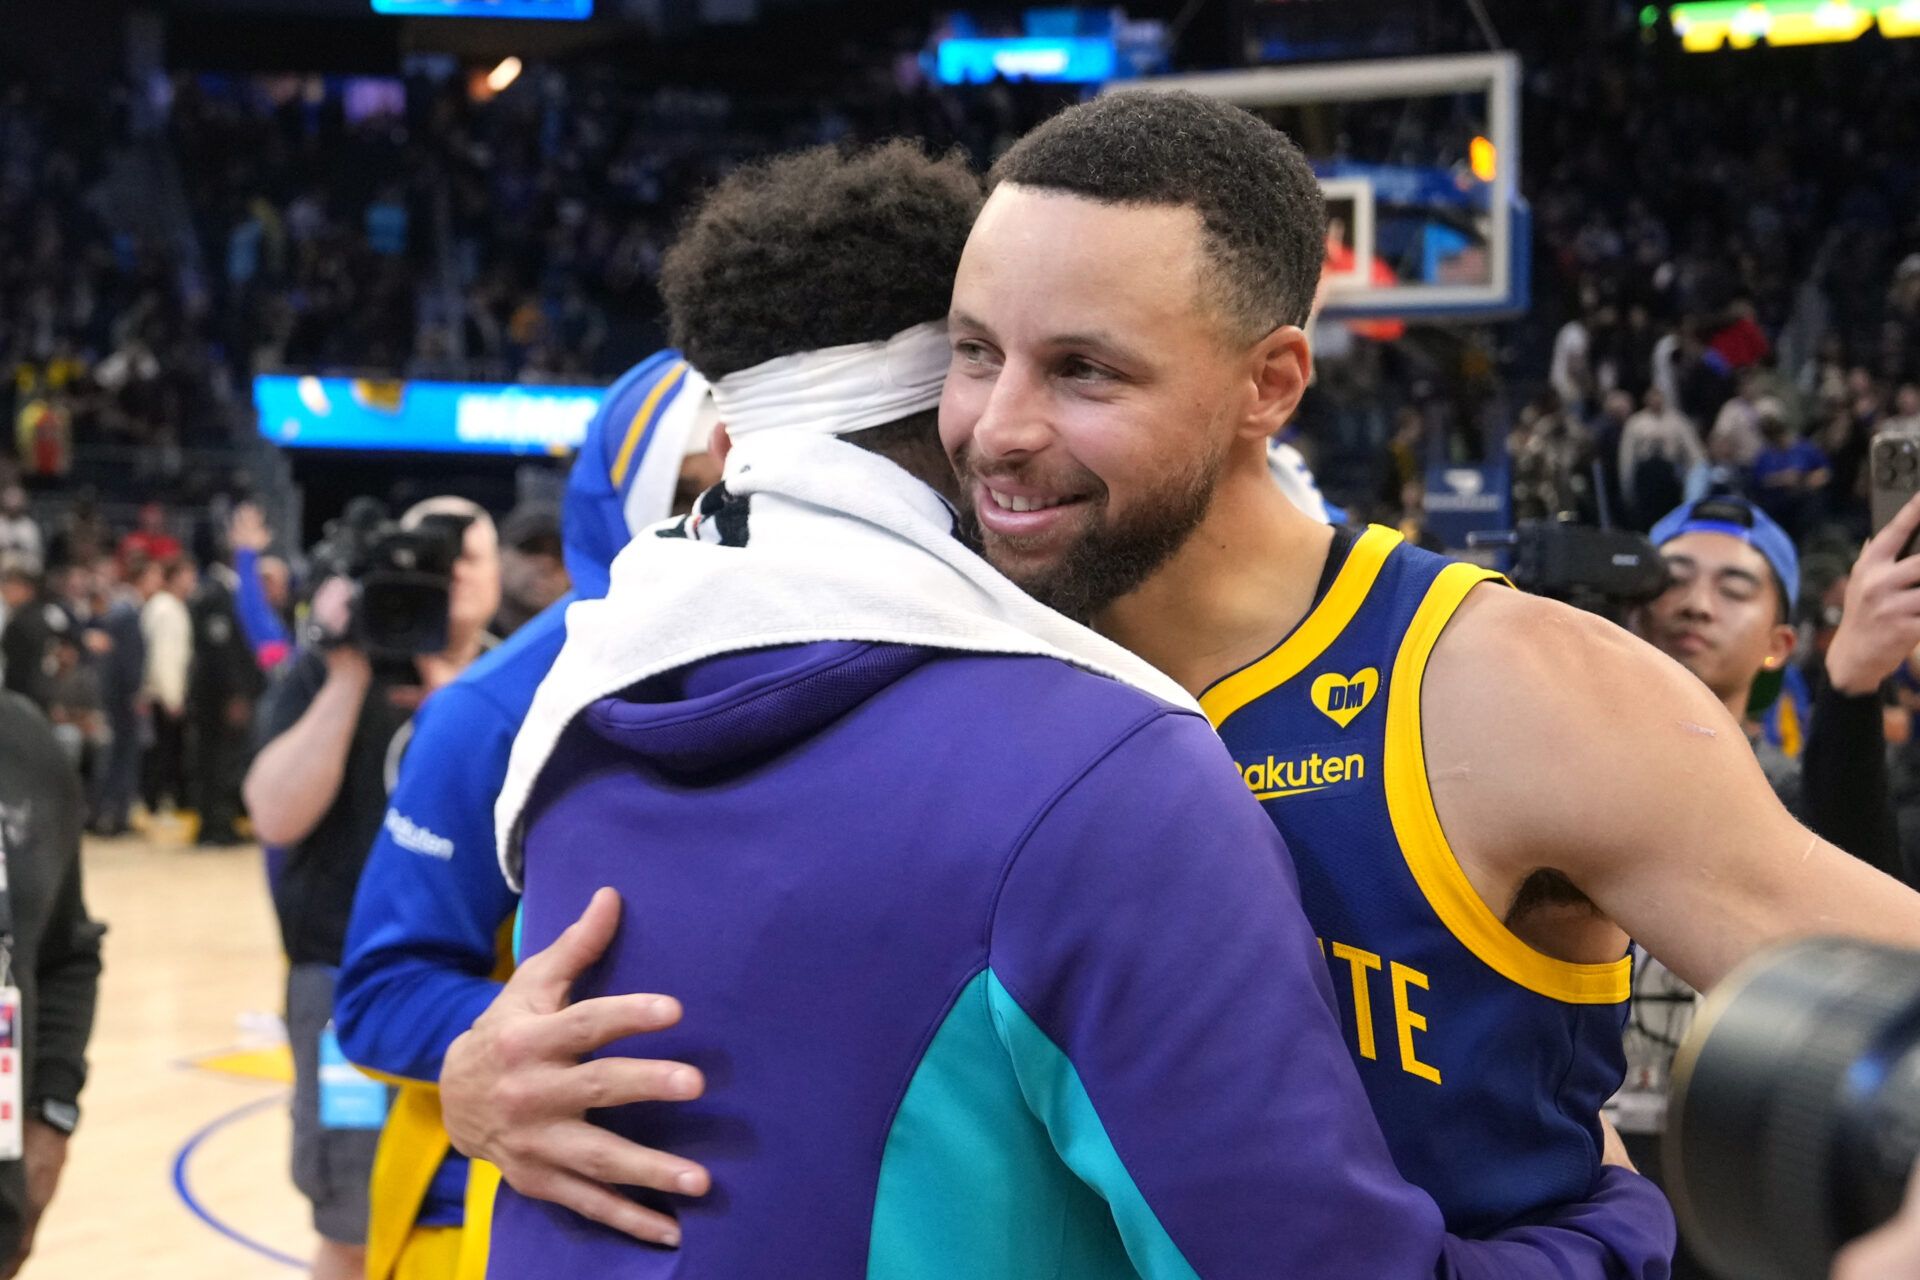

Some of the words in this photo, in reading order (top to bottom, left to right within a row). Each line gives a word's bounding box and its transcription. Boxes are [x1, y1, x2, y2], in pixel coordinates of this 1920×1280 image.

[1327, 681, 1365, 711] DM
[1234, 753, 1365, 791] akuten
[1317, 937, 1442, 1085] TE
